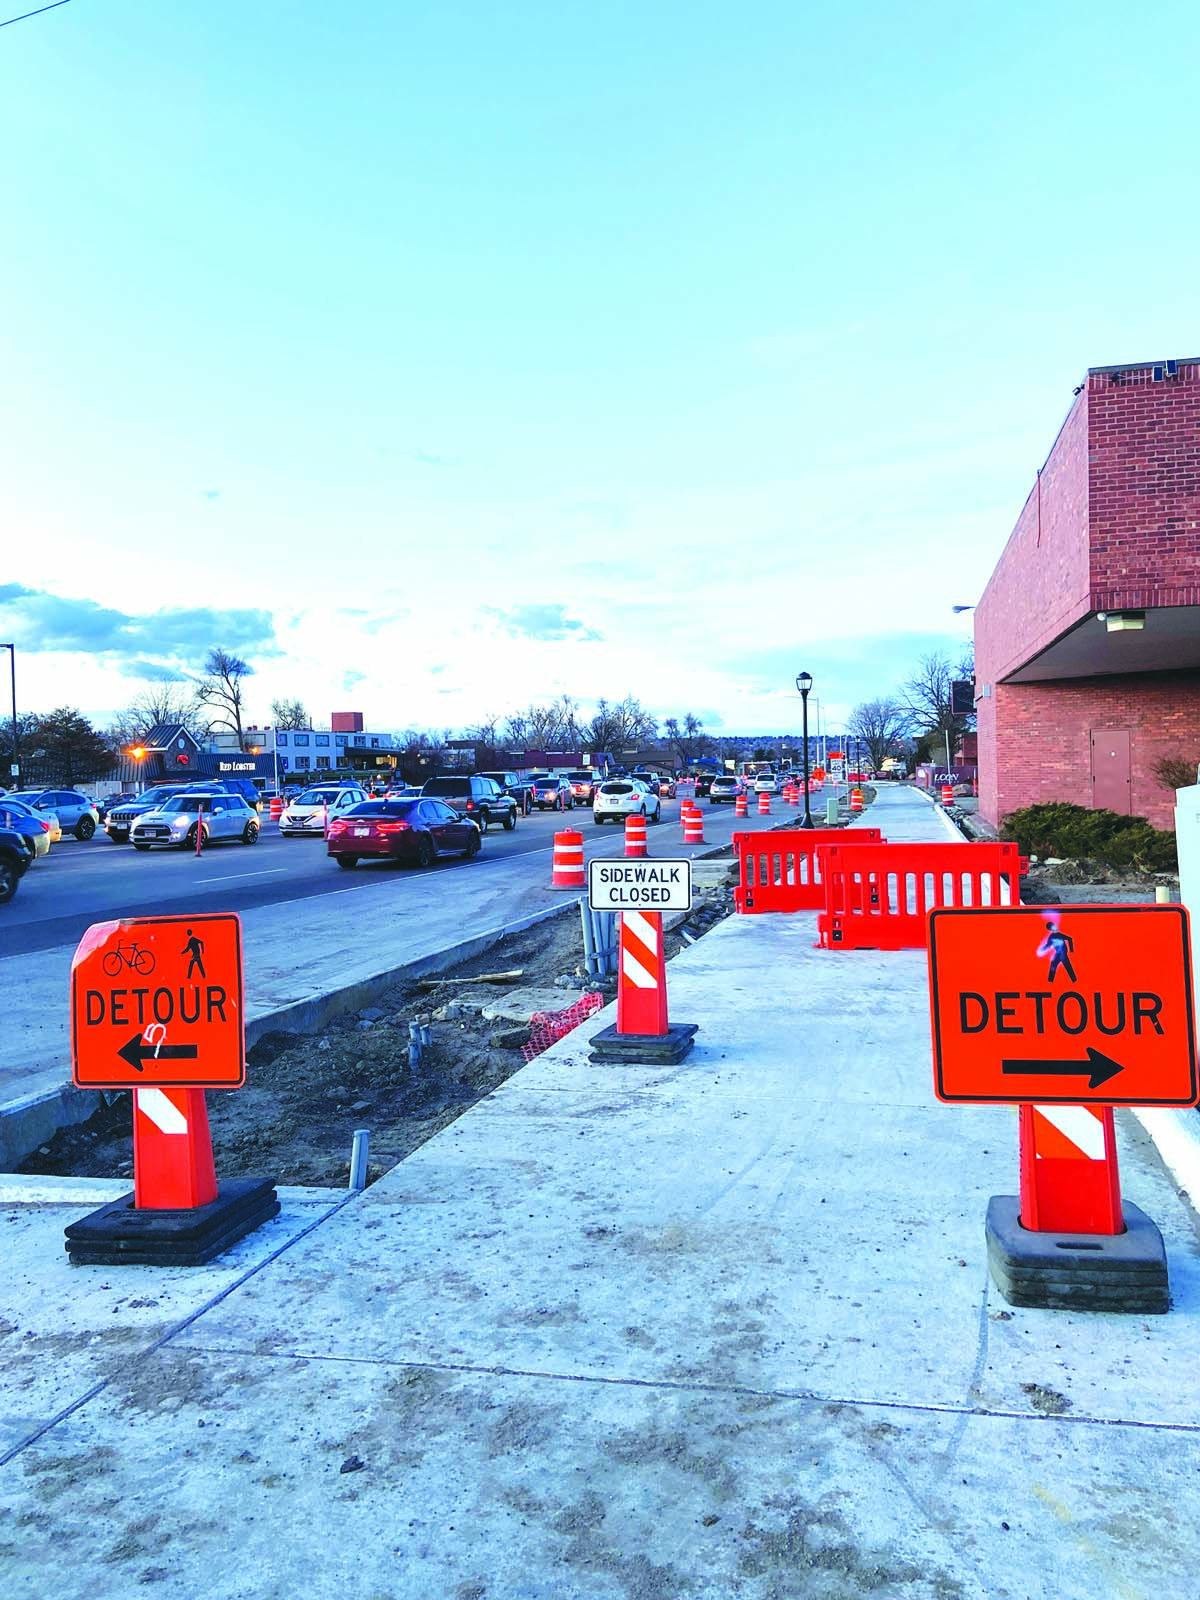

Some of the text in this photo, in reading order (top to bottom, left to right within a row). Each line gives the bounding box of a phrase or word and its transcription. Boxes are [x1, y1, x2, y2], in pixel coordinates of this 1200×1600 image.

[219, 761, 232, 771] RED
[600, 868, 680, 883] SIDEWALK
[609, 887, 671, 903] CLOSED
[86, 985, 227, 1026] DETOUR
[959, 991, 1165, 1035] DETOUR
